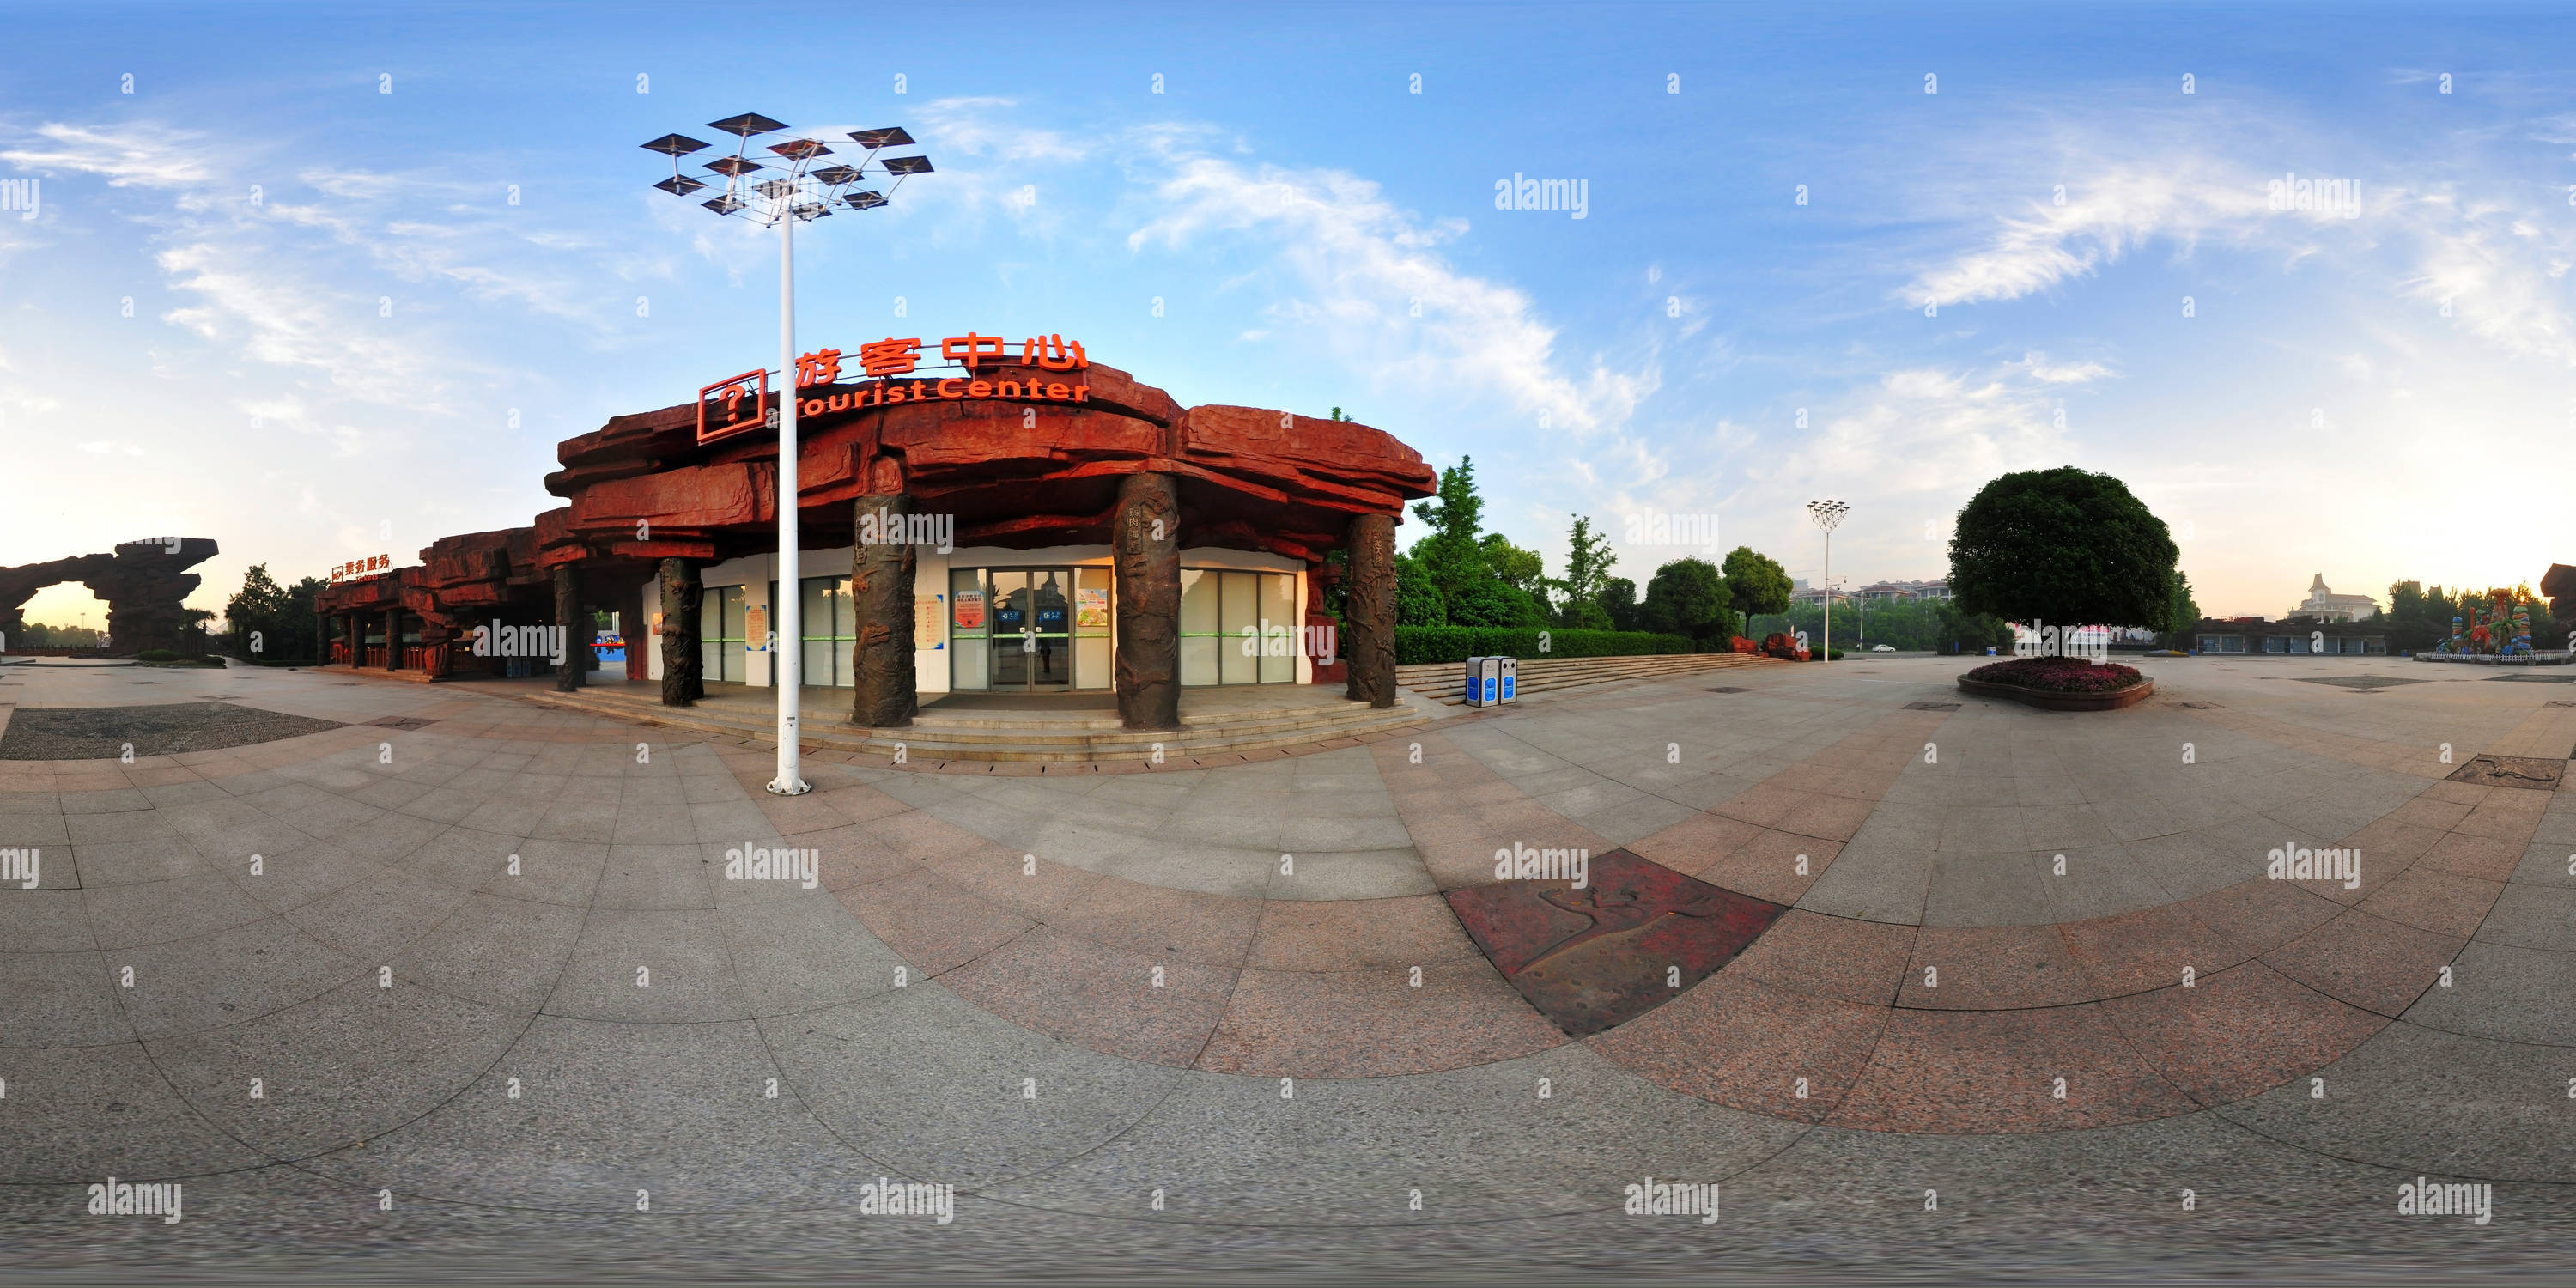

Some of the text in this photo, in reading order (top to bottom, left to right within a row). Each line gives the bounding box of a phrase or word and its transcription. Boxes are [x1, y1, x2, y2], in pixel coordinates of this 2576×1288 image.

[795, 331, 1089, 389] 游客中心
[936, 377, 1091, 404] Center
[345, 554, 389, 575] 票务服务
